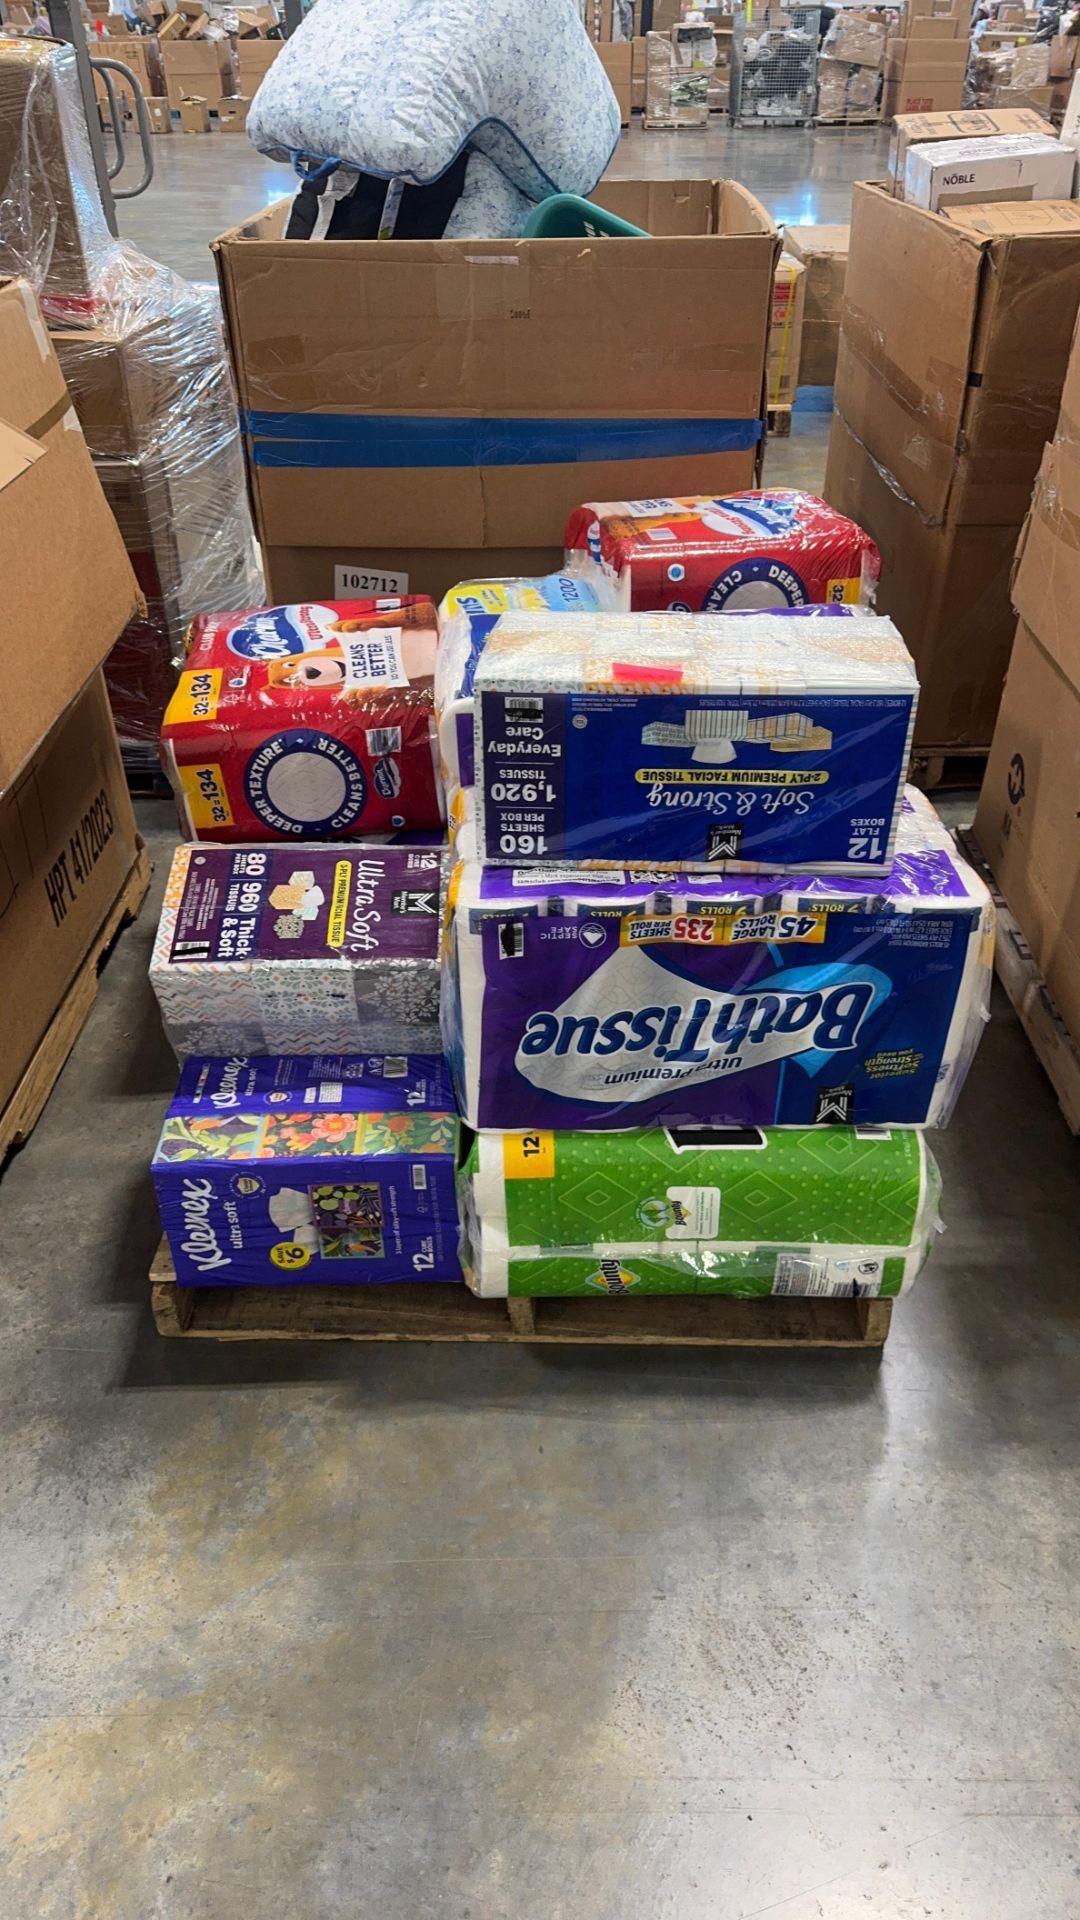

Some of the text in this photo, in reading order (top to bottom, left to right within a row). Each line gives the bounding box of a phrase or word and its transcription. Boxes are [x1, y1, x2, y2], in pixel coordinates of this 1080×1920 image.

[342, 573, 398, 593] 102712
[558, 578, 580, 602] 1200
[199, 633, 215, 651] CLUB
[350, 643, 367, 680] CLEANS
[366, 643, 388, 677] BETTER
[505, 726, 544, 741] Care
[487, 741, 562, 757] Everyday
[499, 769, 546, 779] TISSUES
[642, 771, 821, 783] 2-PLY PREMIUM FACIAL TISSUE
[197, 768, 227, 823] 32=134
[250, 739, 303, 834] DEEPER TEXTURE
[490, 781, 557, 802] 1,920
[331, 782, 363, 829] CLEANS
[646, 783, 815, 816] Soft & Strong
[500, 813, 545, 822] PER BOX
[500, 823, 545, 832] SHEETS
[850, 817, 885, 827] BOXES
[853, 826, 880, 836] FLAT
[499, 834, 548, 855] 160
[848, 838, 883, 860] 12
[240, 854, 248, 875] SHEETS
[246, 852, 266, 876] 80
[421, 852, 437, 869] 12
[44, 850, 77, 928] HPT
[237, 882, 262, 913] 960
[346, 860, 386, 953] Ultra Soft
[217, 917, 237, 957] & Soft
[332, 921, 342, 943] TISSUE
[539, 932, 578, 940] SEPTIC
[628, 926, 672, 940] SHEETS
[629, 920, 672, 932] PER ROLL
[674, 917, 715, 941] 235
[731, 925, 776, 941] LARGE
[779, 916, 816, 938] 45
[234, 917, 256, 958] Thick
[696, 1055, 743, 1073] Ultra
[210, 1056, 249, 1109] Kleenex
[406, 1091, 426, 1107] 12
[523, 1136, 540, 1158] 12
[671, 1200, 688, 1226] Bounty
[180, 1178, 233, 1271] Kleenex
[223, 1200, 244, 1250] ultra soft
[412, 1252, 434, 1272] 12
[600, 1259, 630, 1294] Bounty
